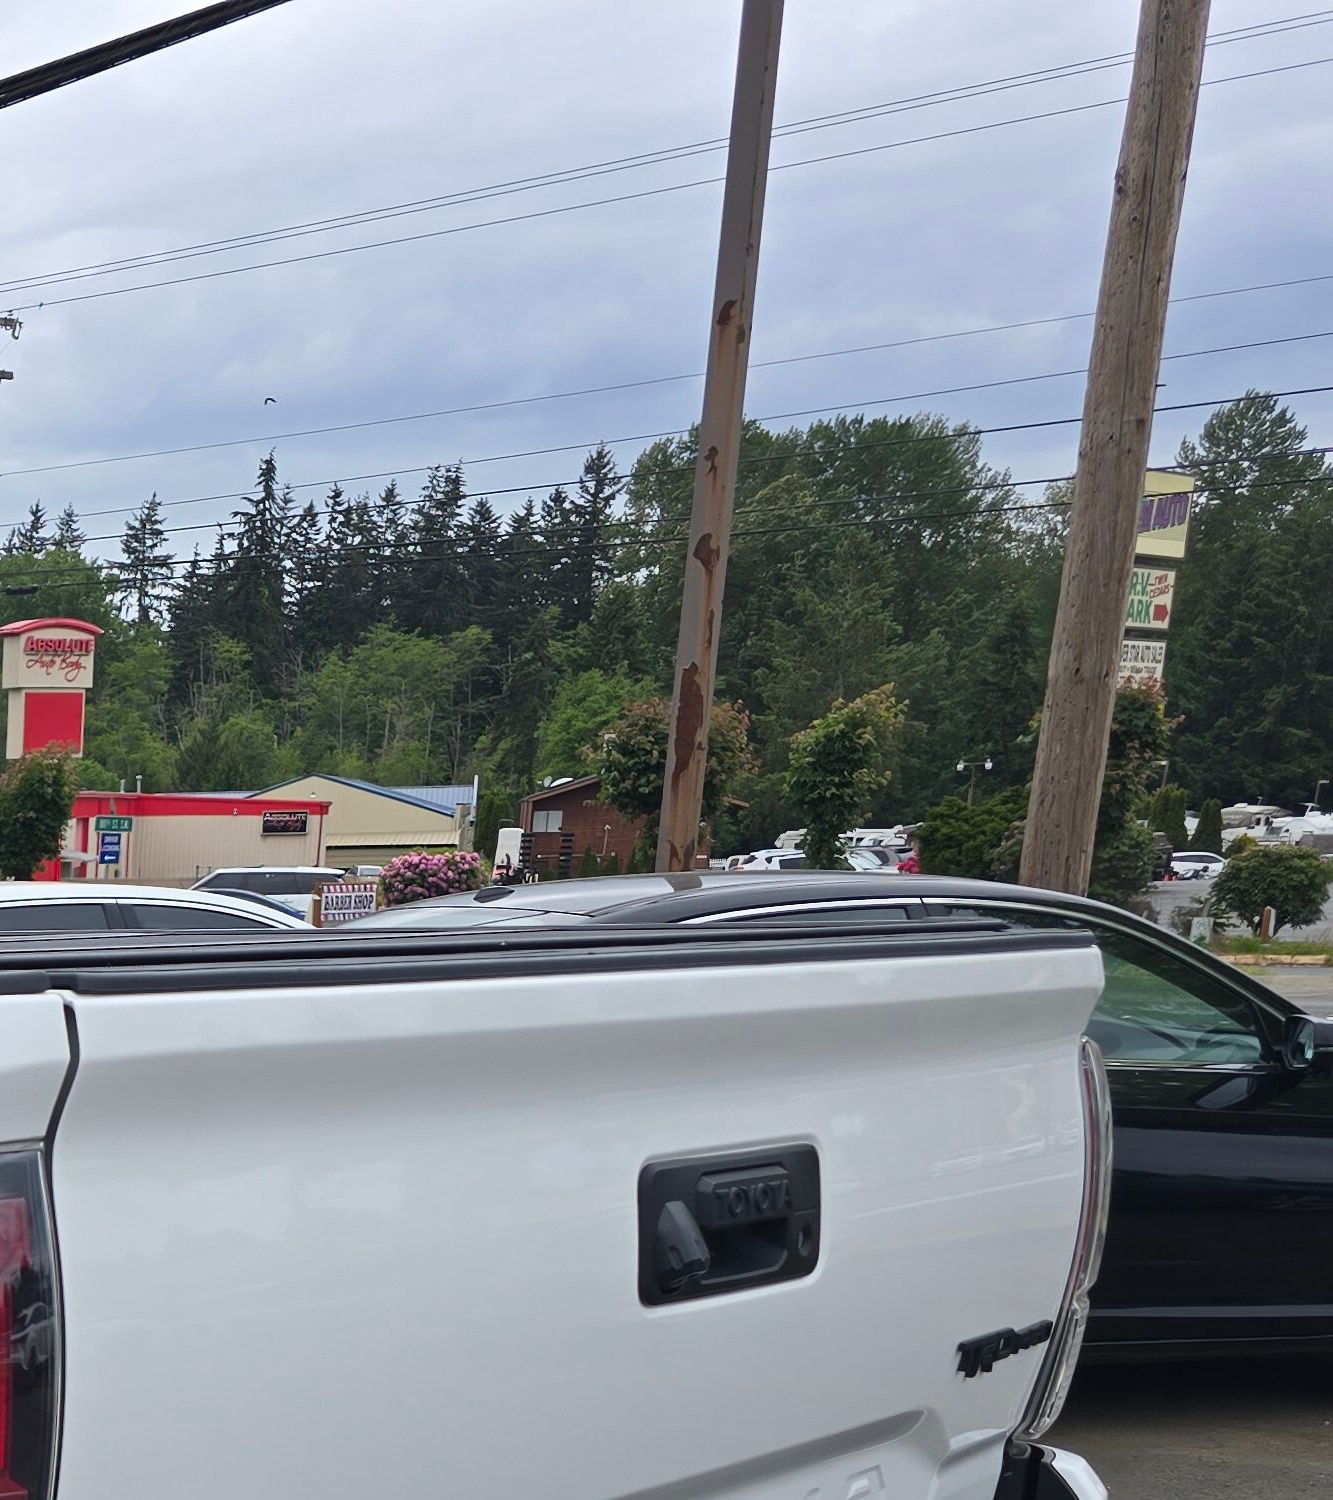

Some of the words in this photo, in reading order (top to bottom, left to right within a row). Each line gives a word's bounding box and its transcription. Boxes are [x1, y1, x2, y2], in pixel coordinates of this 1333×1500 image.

[1152, 493, 1190, 531] AUTO
[1125, 598, 1153, 625] ARK
[23, 636, 95, 653] ABSOLUTE
[26, 654, 56, 676] Auto
[58, 653, 87, 682] Body
[324, 895, 352, 911] BARBER
[353, 894, 374, 910] SHOP
[714, 1180, 791, 1216] TOYOTA
